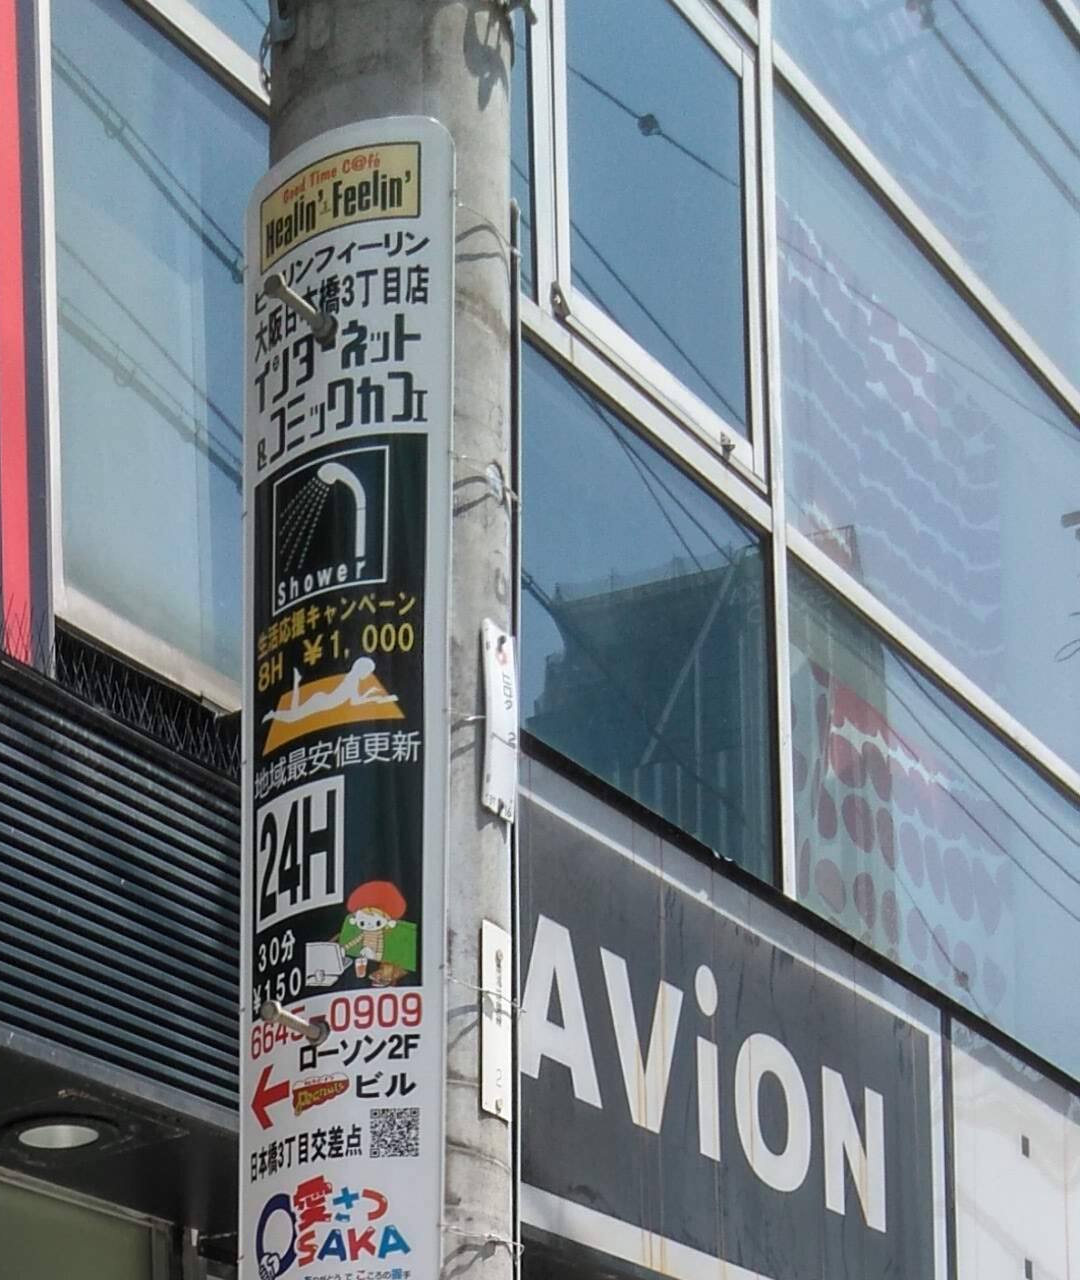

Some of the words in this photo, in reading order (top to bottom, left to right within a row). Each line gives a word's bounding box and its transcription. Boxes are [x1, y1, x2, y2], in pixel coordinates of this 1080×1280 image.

[310, 166, 338, 186] Time
[332, 169, 411, 219] Feelin'
[255, 231, 430, 315] ヒリンフィーリン
[255, 314, 421, 413] インタネット
[277, 560, 367, 606] Shower
[254, 730, 421, 801] 地域最安値更新
[260, 789, 337, 923] 24H
[258, 928, 297, 973] 30分
[355, 1071, 417, 1099] ビル
[250, 1124, 363, 1183] 日本橋3丁目交差点
